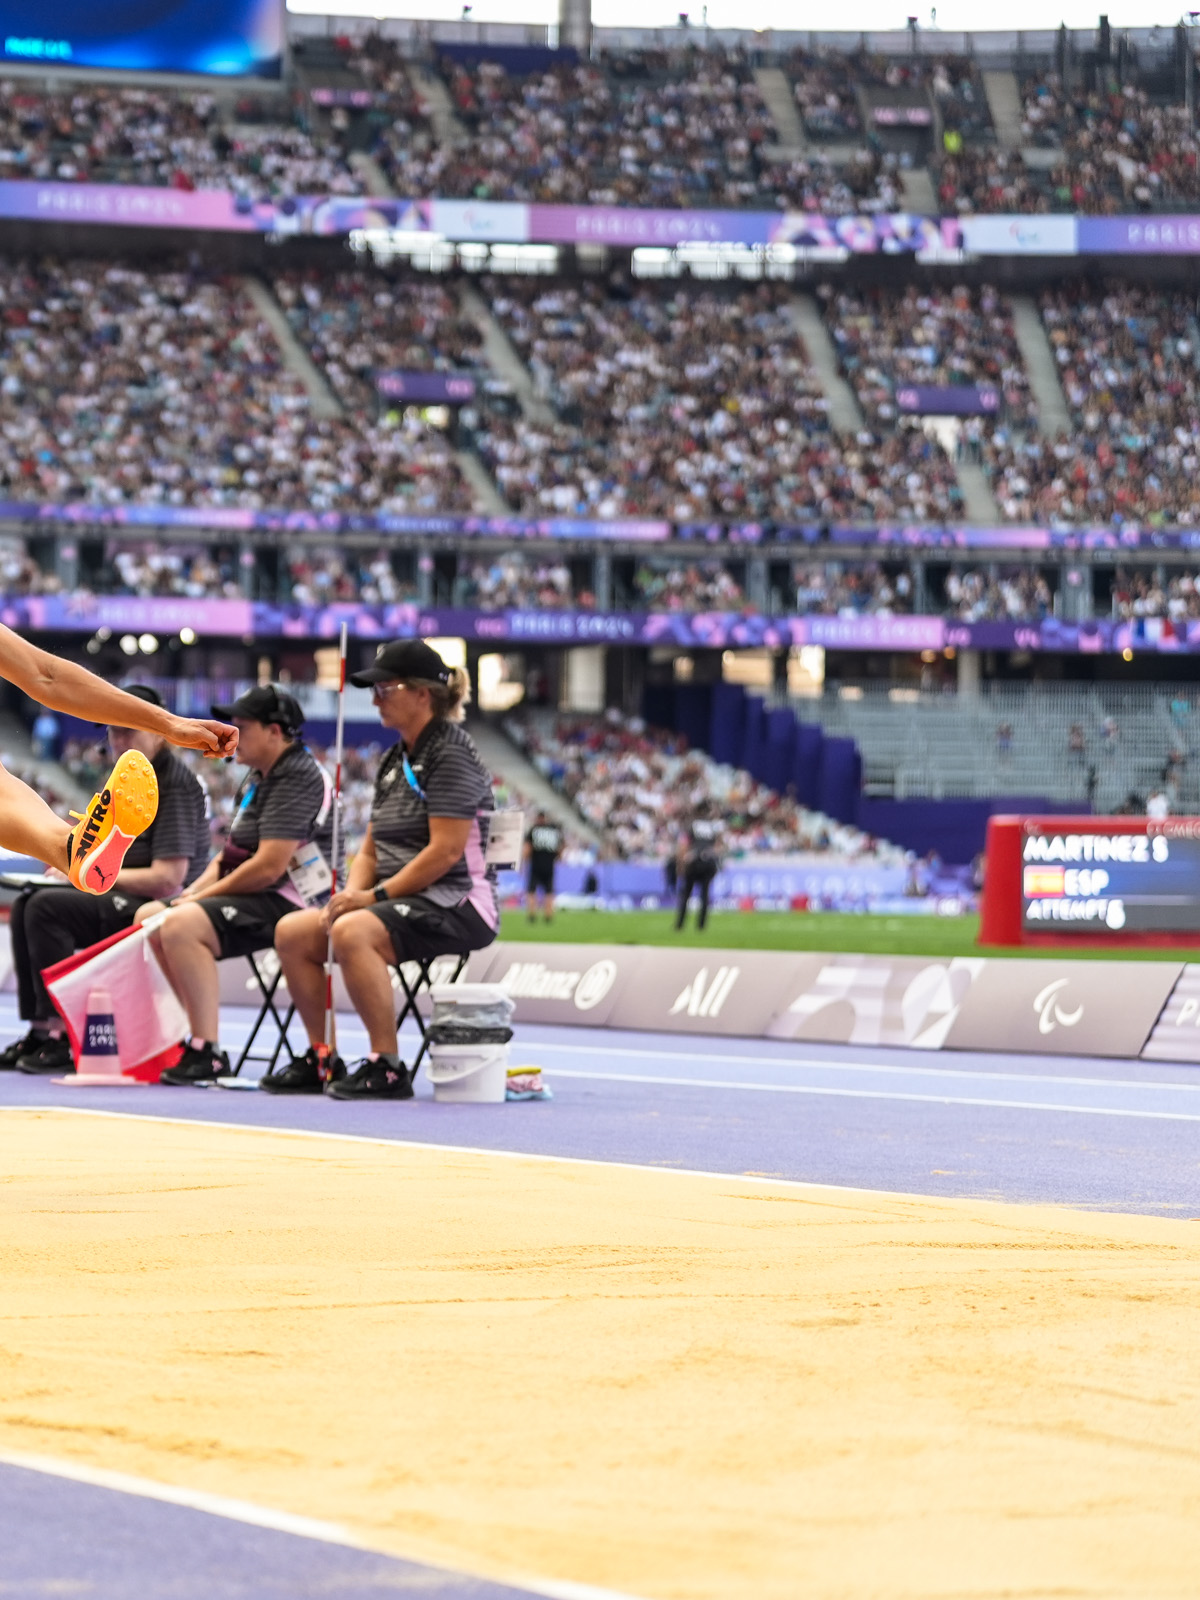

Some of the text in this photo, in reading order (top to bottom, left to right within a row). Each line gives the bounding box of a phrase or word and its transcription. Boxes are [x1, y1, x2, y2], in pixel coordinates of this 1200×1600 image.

[575, 213, 647, 236] PARIS
[511, 613, 575, 638] PARIS
[75, 789, 111, 864] NITRO
[1023, 834, 1169, 863] MARTINEZ S
[1064, 868, 1109, 896] ESP
[1026, 898, 1109, 921] ATTEMPT
[501, 962, 580, 999] Allianz
